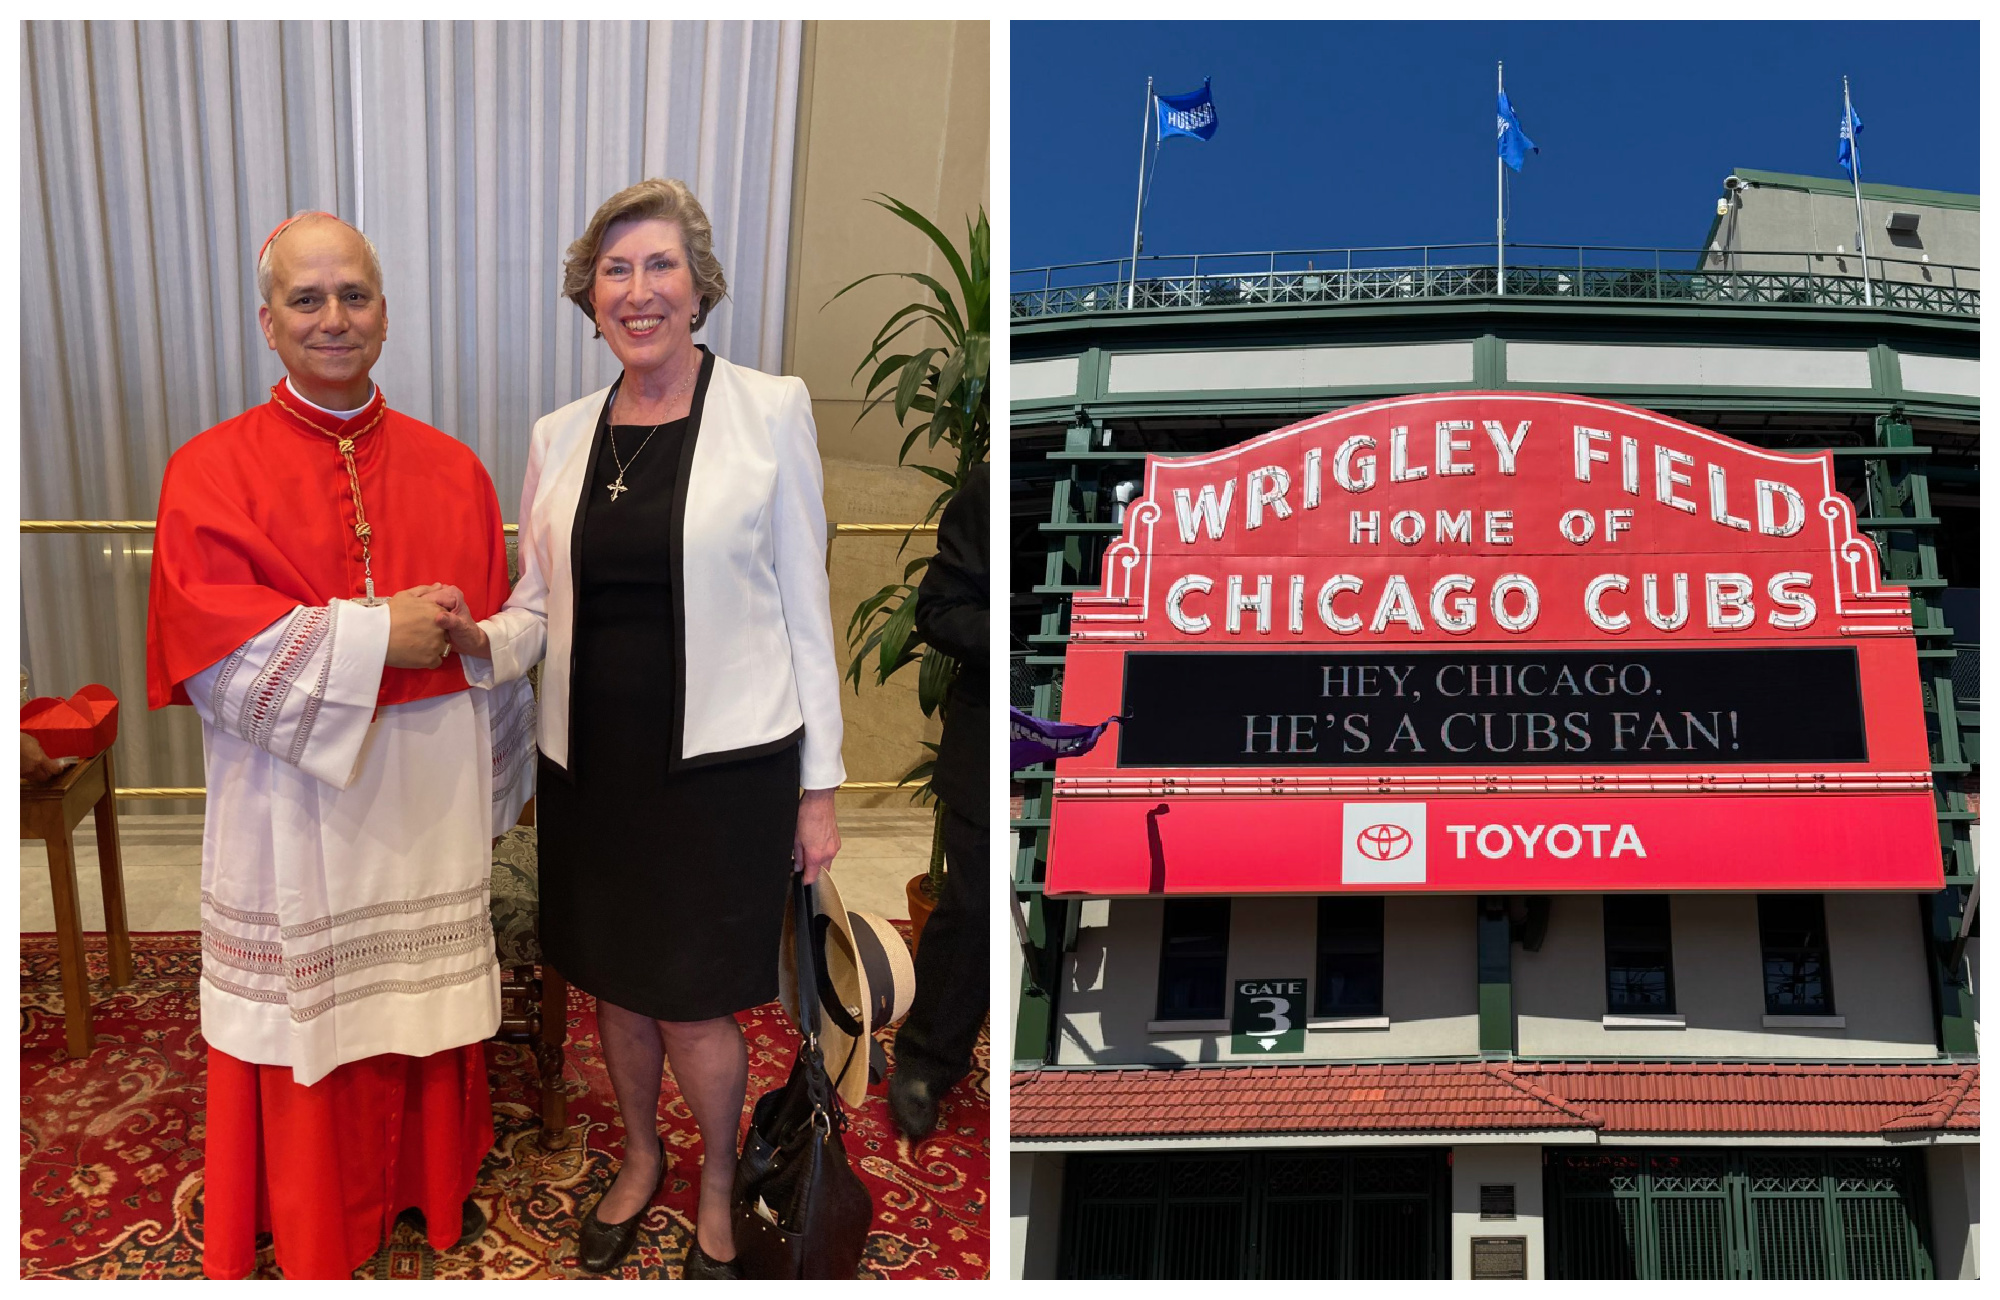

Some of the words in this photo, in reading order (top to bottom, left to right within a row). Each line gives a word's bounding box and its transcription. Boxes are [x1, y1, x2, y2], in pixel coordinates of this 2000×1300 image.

[1173, 420, 1532, 544] WRIGLEY
[1573, 425, 1806, 537] FIELD
[1349, 510, 1514, 545] HOME
[1559, 509, 1634, 544] OF
[1165, 573, 1540, 635] CHICAGO
[1584, 571, 1817, 633] CUBS
[1320, 665, 1421, 702] HEY,
[1435, 664, 1663, 697] CHICAGO.
[1241, 713, 1371, 754] HE’S
[1384, 713, 1428, 753] A
[1440, 711, 1591, 753] CUBS
[1610, 710, 1741, 751] FAN!
[1446, 824, 1647, 859] TOYOTA
[1240, 982, 1302, 995] GATE
[1245, 997, 1291, 1036] 3
